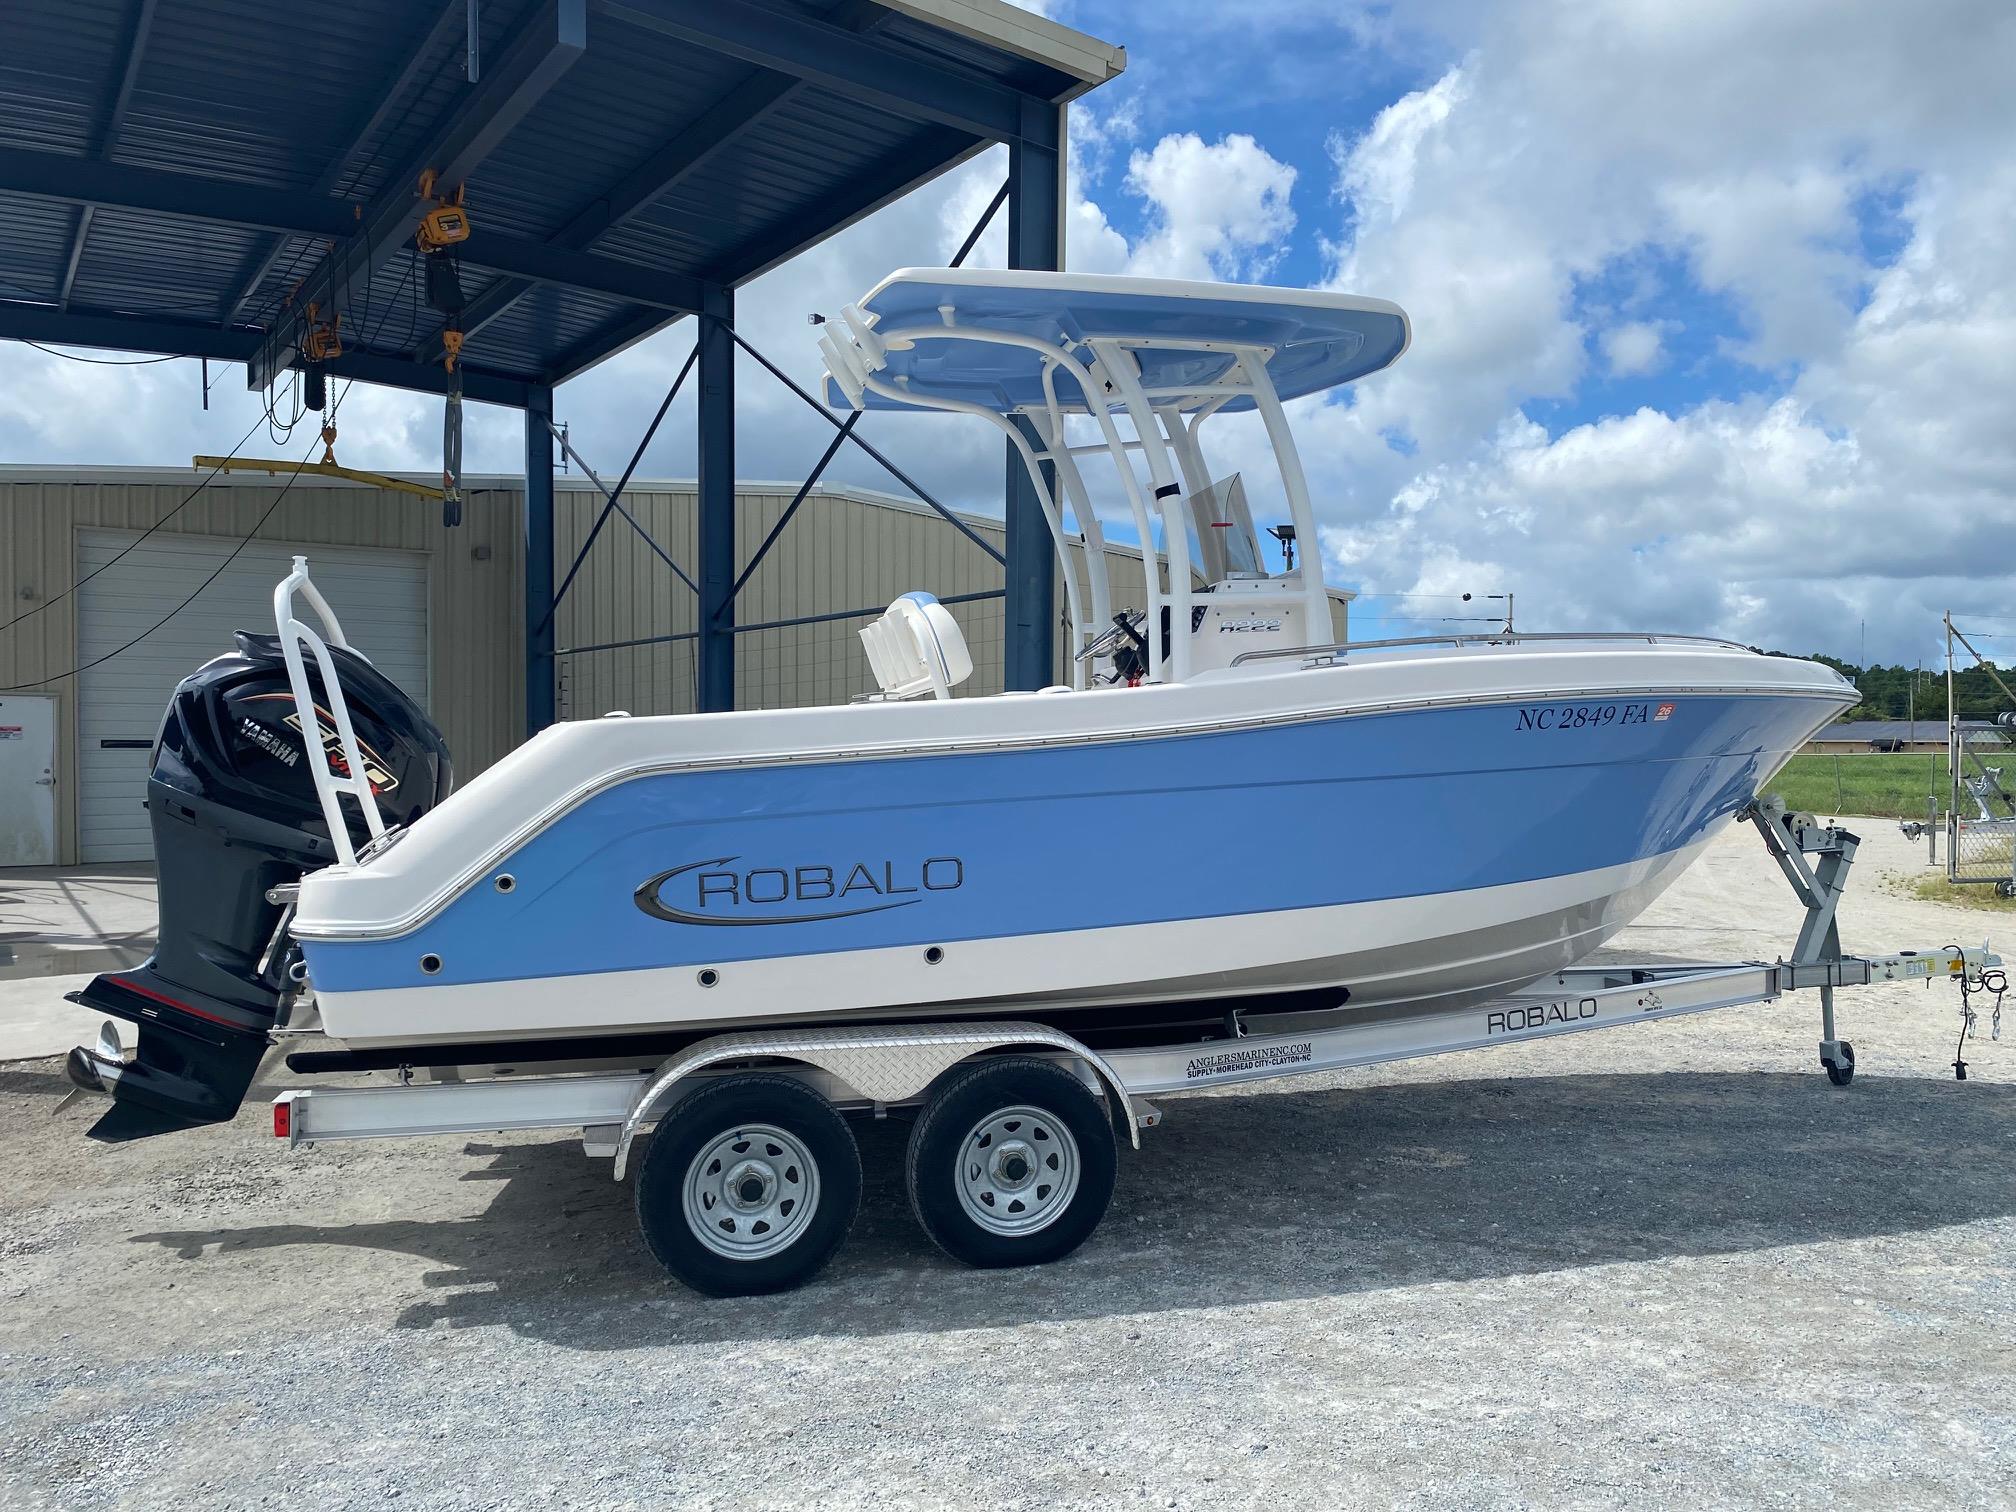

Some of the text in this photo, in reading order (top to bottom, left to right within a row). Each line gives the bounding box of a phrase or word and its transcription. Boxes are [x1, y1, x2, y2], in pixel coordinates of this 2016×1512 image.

[1220, 619, 1281, 633] R222
[1514, 704, 1649, 731] NC 2849 FA
[1657, 706, 1672, 716] 26
[240, 718, 300, 768] YAMAHA
[698, 856, 963, 908] ROBALO
[1487, 998, 1598, 1035] ROBALO
[1186, 1043, 1312, 1071] ANGLERSMARINENC.COM
